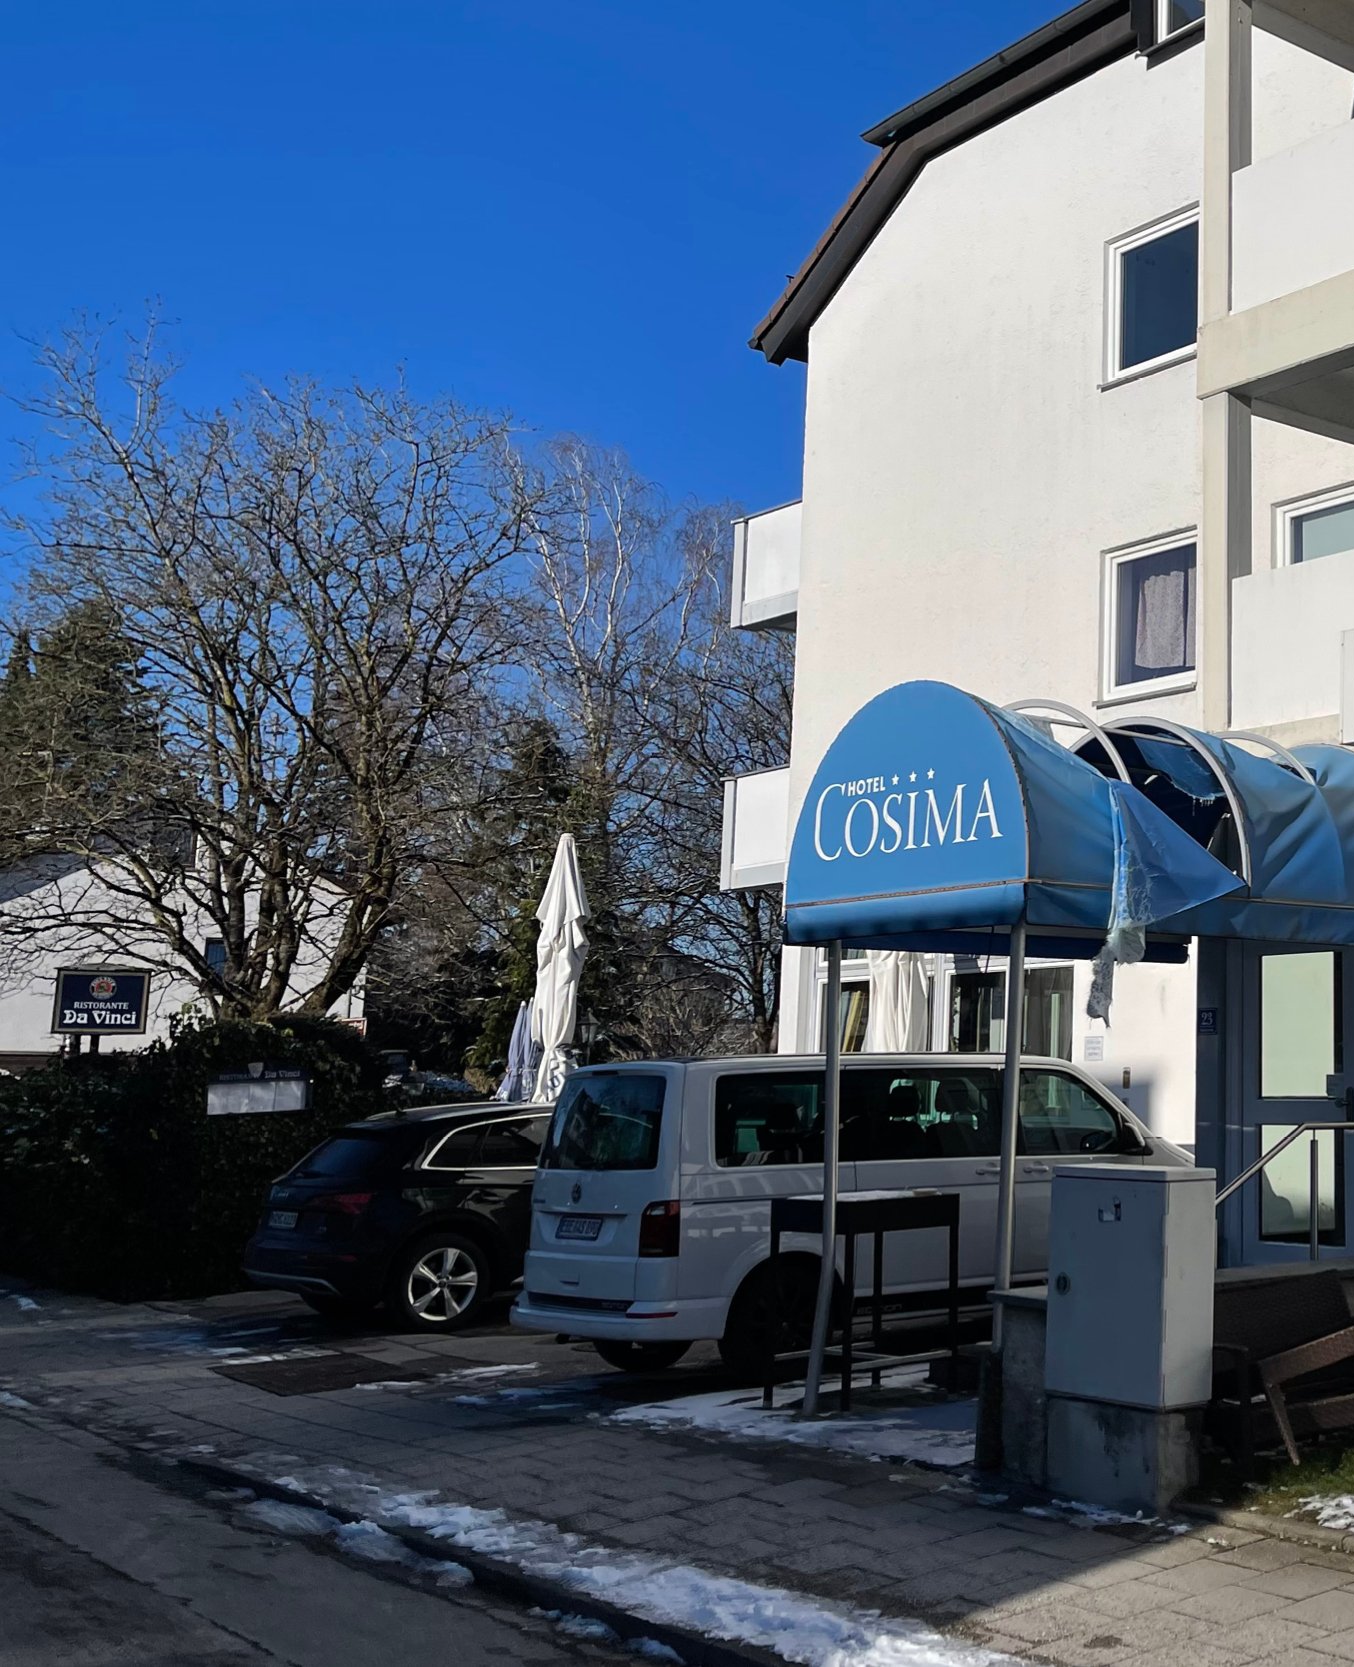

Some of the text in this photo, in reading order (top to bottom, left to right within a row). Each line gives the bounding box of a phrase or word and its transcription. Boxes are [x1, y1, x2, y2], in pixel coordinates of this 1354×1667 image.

[847, 776, 886, 797] HOTEL
[814, 778, 1004, 861] COSIMA
[73, 1001, 130, 1010] RISTORANTE
[63, 1010, 137, 1025] Da Vinci
[1201, 1012, 1213, 1025] 23
